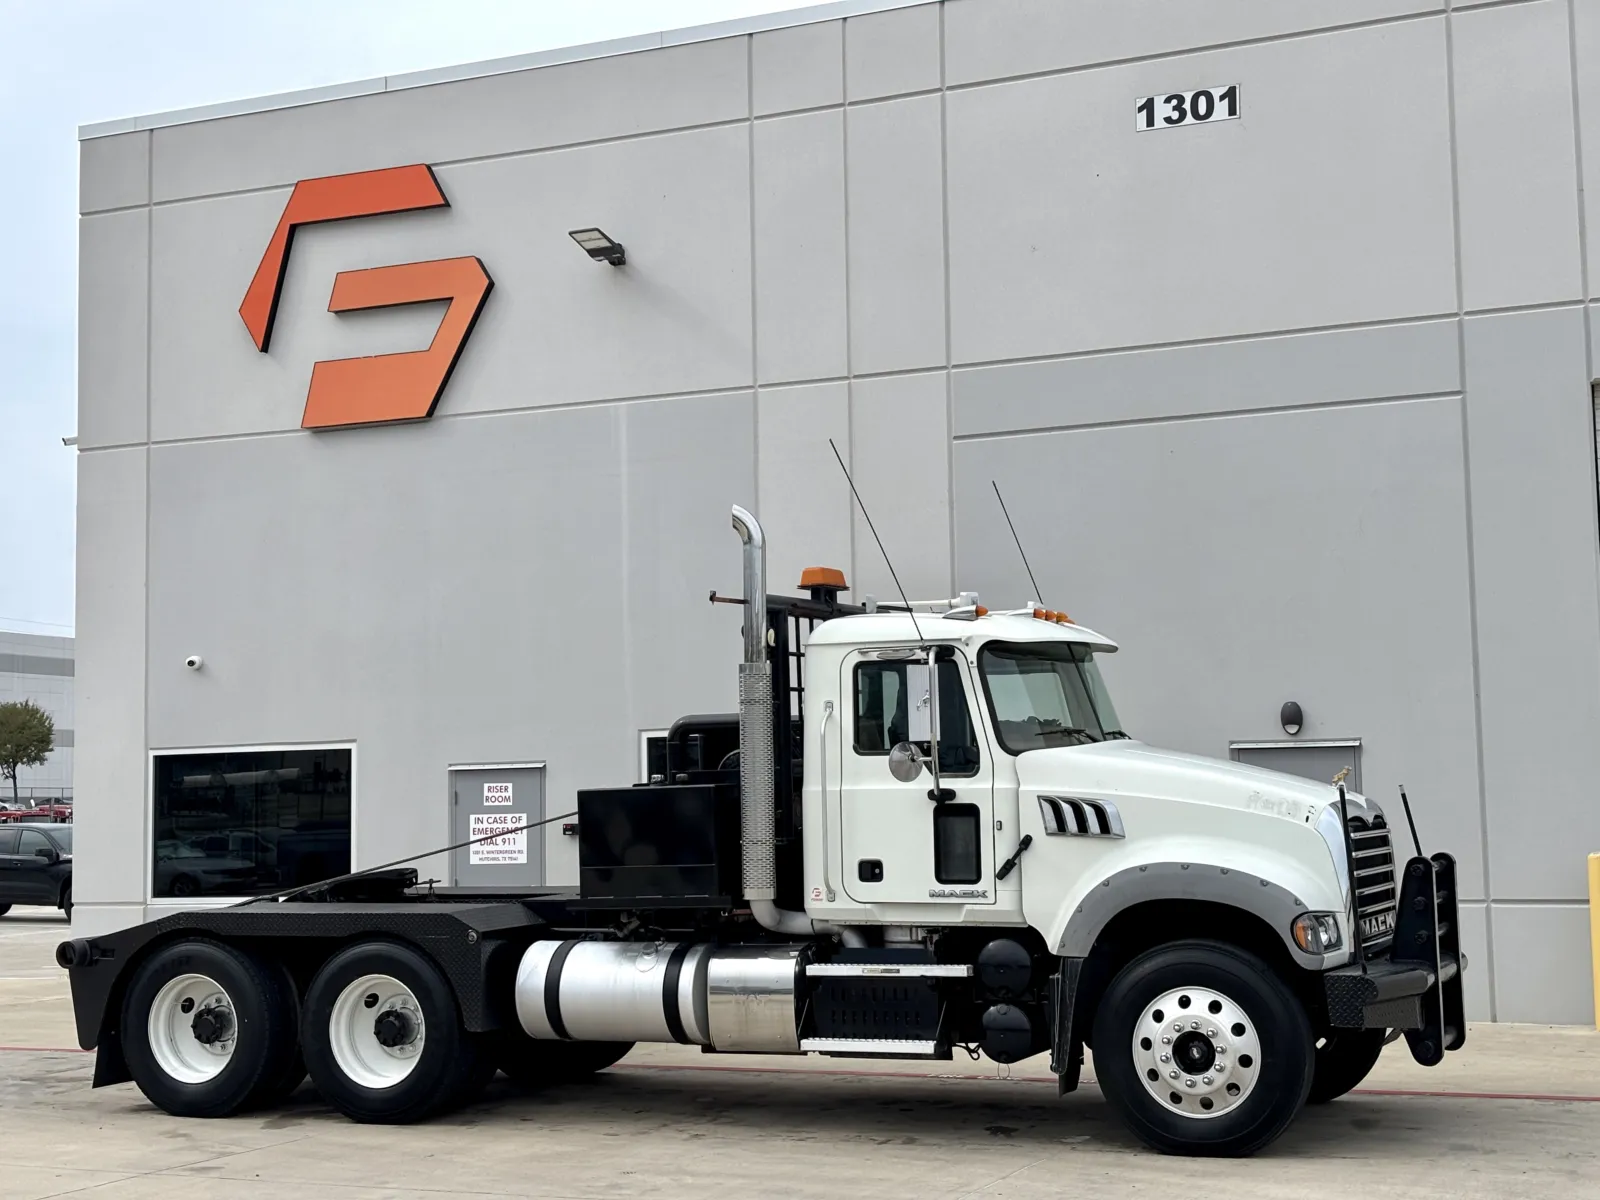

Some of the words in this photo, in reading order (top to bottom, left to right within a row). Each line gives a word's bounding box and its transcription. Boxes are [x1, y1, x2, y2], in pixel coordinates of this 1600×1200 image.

[1137, 85, 1237, 129] 1301
[487, 785, 509, 793] RISER
[485, 796, 511, 804] ROOM
[474, 816, 484, 825] IN
[486, 816, 508, 825] CASE
[511, 815, 523, 824] OF
[480, 837, 499, 846] DIAL
[501, 837, 516, 846] 911
[928, 889, 989, 898] MACK
[1361, 913, 1394, 935] MACK
